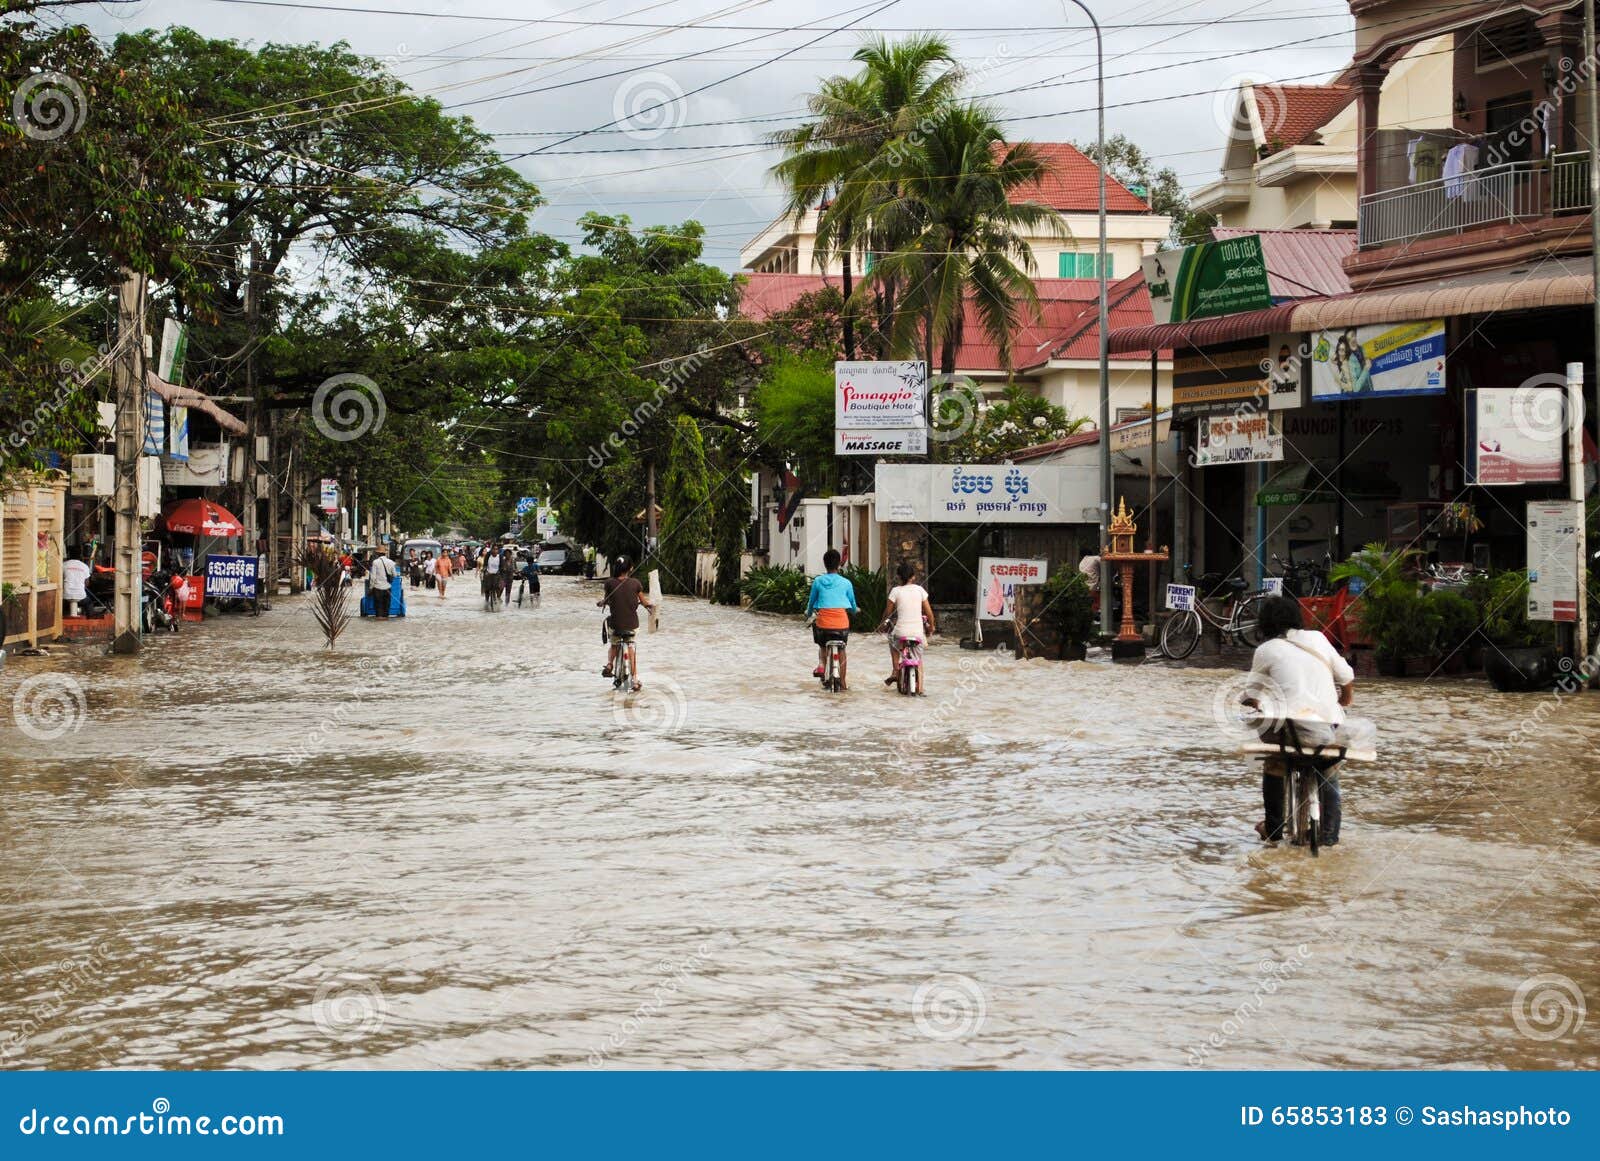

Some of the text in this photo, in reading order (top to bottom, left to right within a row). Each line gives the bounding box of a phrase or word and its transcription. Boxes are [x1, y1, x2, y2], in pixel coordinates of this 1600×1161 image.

[850, 402, 916, 411] Boutique Hotel
[845, 441, 902, 451] MASSAGE
[1224, 447, 1254, 462] LAUNDRY
[207, 576, 240, 593] LAUNDRY
